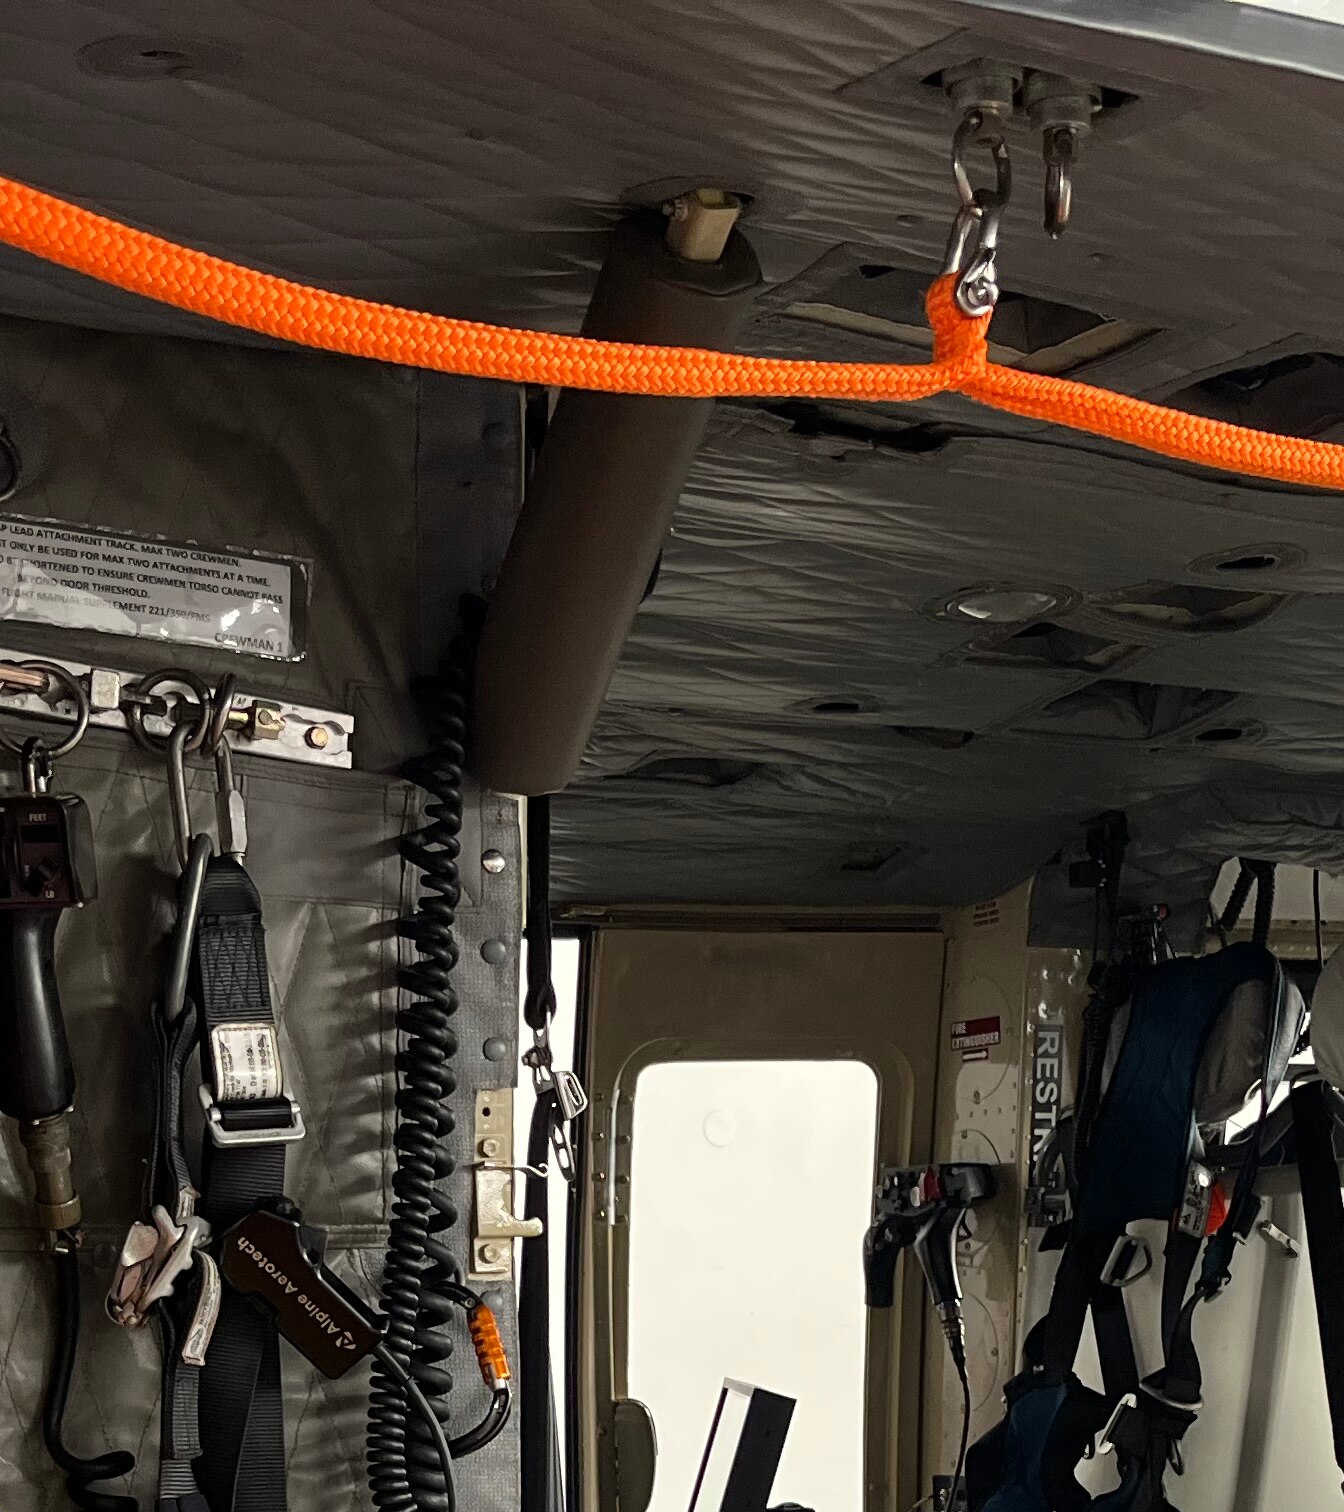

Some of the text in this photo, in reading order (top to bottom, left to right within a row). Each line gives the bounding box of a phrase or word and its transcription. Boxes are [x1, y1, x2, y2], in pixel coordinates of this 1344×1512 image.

[9, 524, 34, 537] LEAD
[35, 528, 102, 547] ATTACHMENT
[141, 544, 163, 556] MAX
[166, 547, 189, 559] TWO
[9, 541, 34, 554] ONLY
[37, 544, 49, 555] BE
[52, 546, 77, 559] USED
[80, 549, 100, 561] FOR
[102, 553, 125, 565] MAX
[127, 557, 150, 569] TWO
[152, 560, 221, 580] ATTACHMENTS
[222, 571, 235, 581] AT
[237, 573, 244, 582] A
[81, 564, 95, 576] TO
[97, 566, 134, 581] ENSURE
[137, 573, 186, 589] CREWMEN
[189, 581, 219, 594] TORSO
[221, 587, 259, 600] CANNOT
[214, 632, 274, 652] CREWMAN
[237, 1236, 341, 1334] Alpine Aerotech
